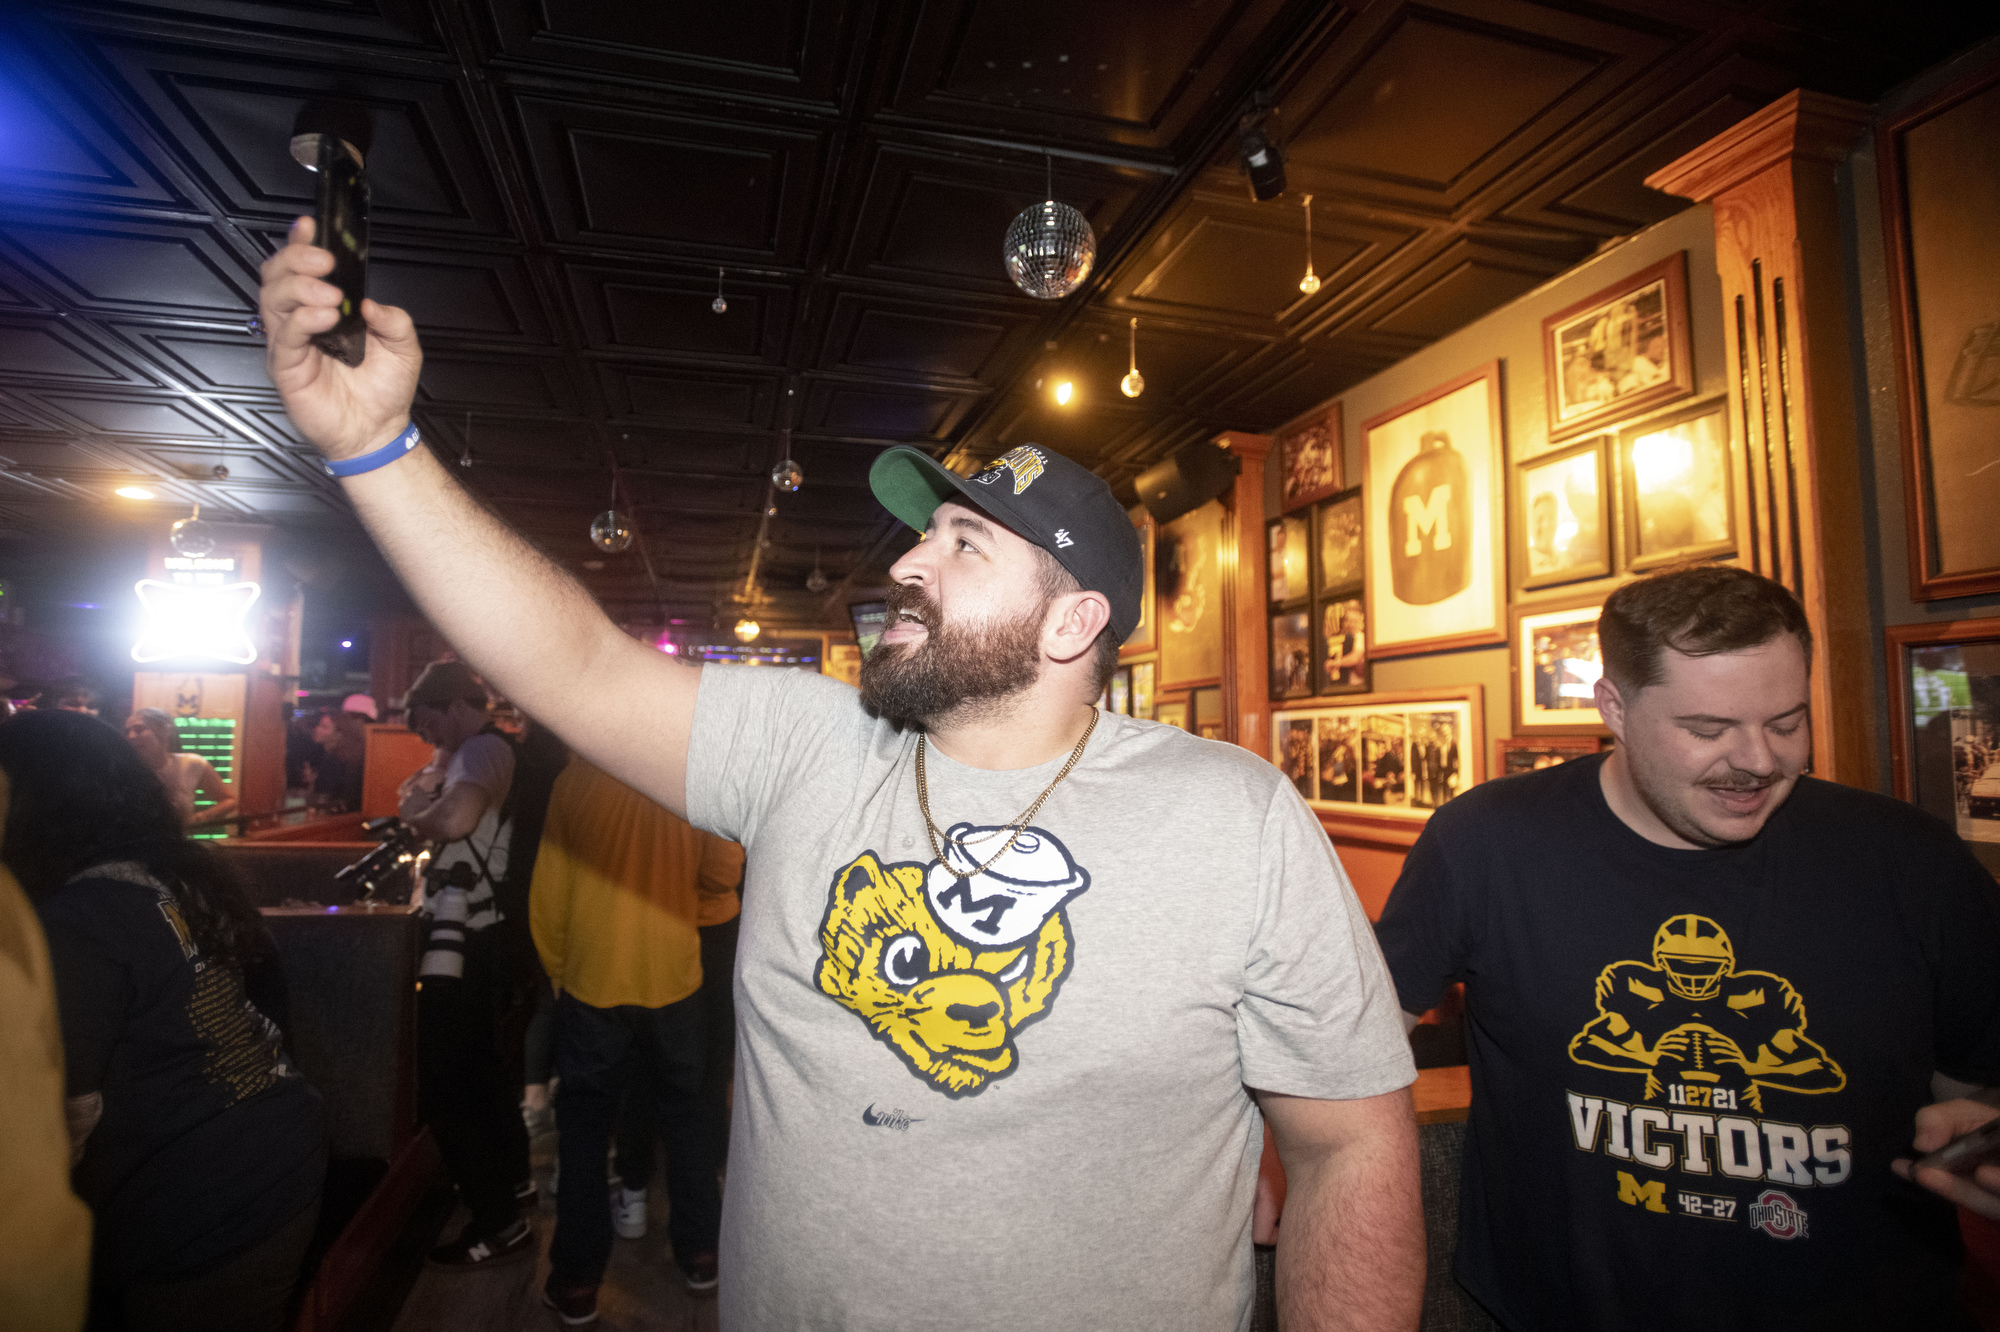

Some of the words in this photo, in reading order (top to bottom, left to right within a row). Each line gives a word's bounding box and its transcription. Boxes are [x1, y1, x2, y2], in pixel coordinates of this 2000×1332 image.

[1403, 483, 1452, 558] M
[936, 876, 1017, 935] M
[1668, 1084, 1739, 1111] 112721
[1566, 1089, 1852, 1189] VICTORS
[1616, 1170, 1670, 1214] M
[1678, 1193, 1737, 1218] 42-27
